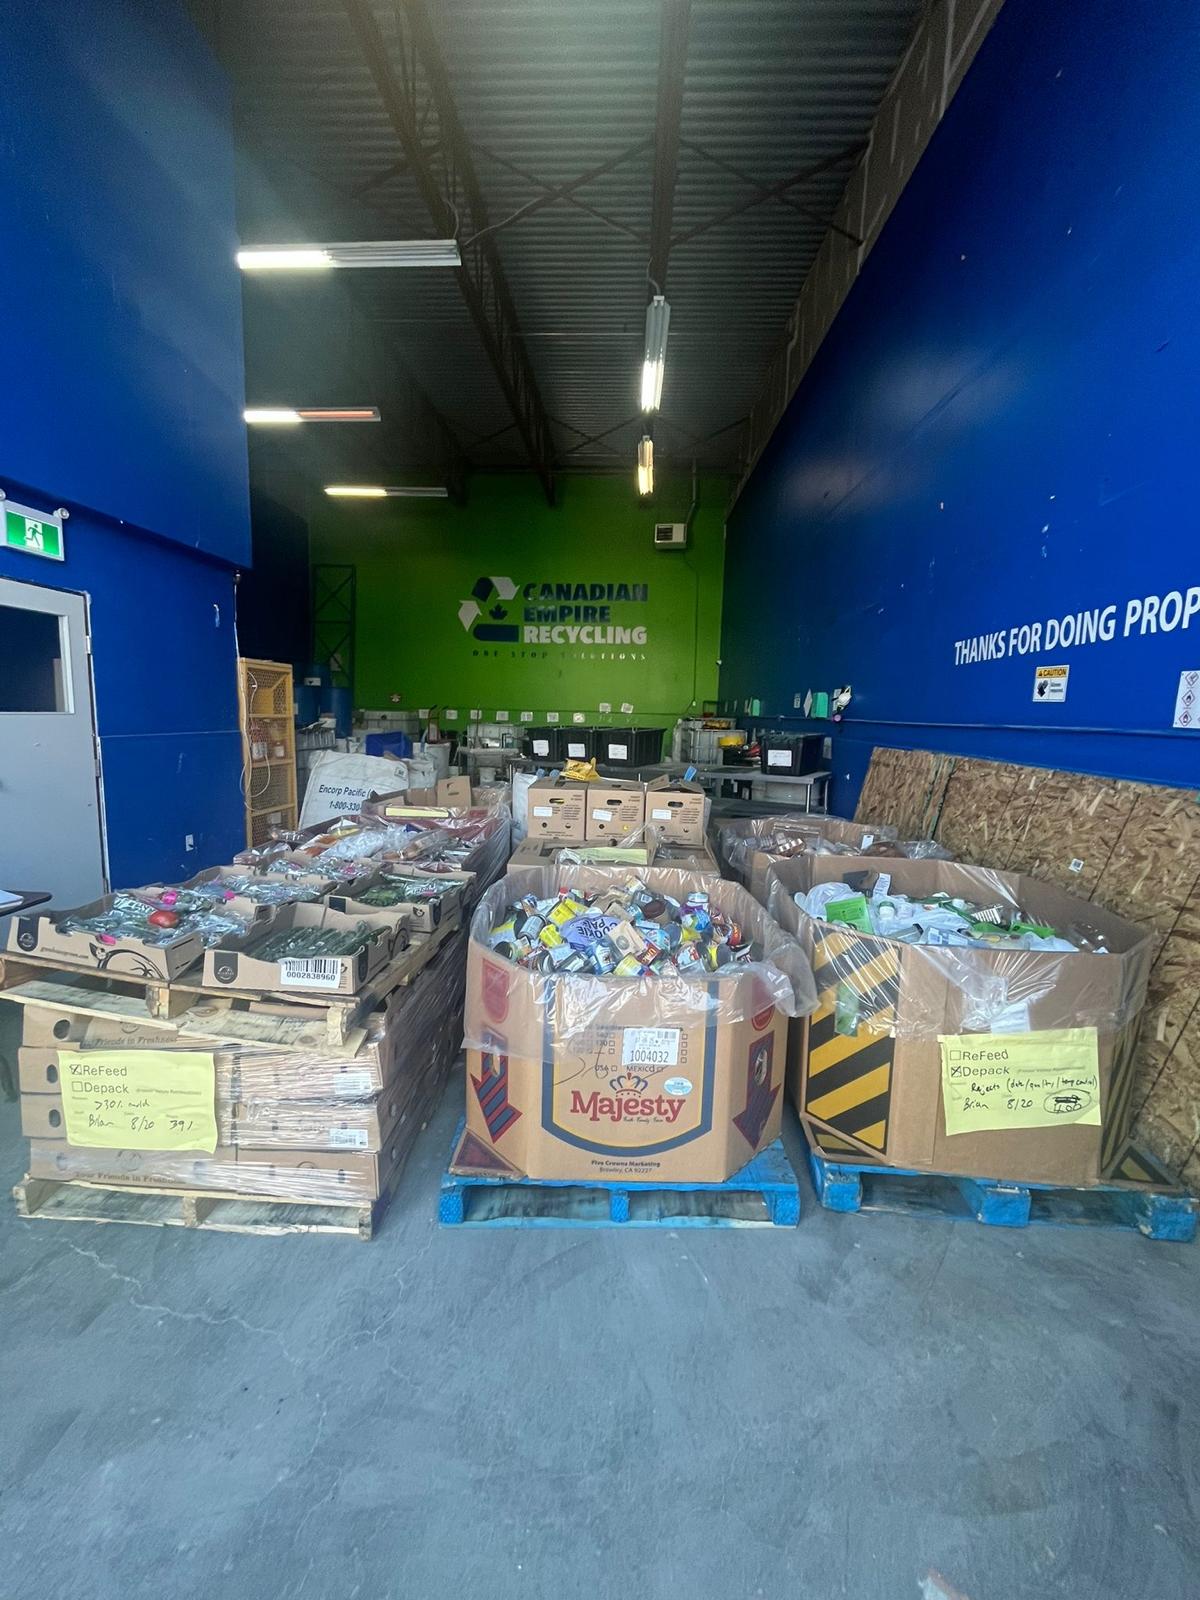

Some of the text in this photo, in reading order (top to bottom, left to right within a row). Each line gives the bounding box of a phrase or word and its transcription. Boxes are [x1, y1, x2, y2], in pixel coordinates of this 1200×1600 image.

[523, 583, 648, 602] CANADIAN
[524, 605, 610, 623] EMPIRE
[954, 586, 1200, 666] THANKS FOR DOING PROP
[524, 625, 648, 645] RECYCLING
[1043, 668, 1067, 676] CAUTION
[319, 784, 342, 796] Encorp
[343, 787, 367, 797] Pacific
[286, 971, 336, 981] 0002838960
[629, 1050, 669, 1063] 1004032
[962, 1049, 1009, 1061] ReFeed
[83, 1066, 128, 1076] ReFeed
[963, 1066, 1010, 1077] Depack
[84, 1082, 129, 1095] Depack
[570, 1090, 686, 1123] Majesty
[963, 1097, 989, 1111] Brian
[1007, 1098, 1033, 1111] 8/20
[131, 1116, 155, 1132] 8/20
